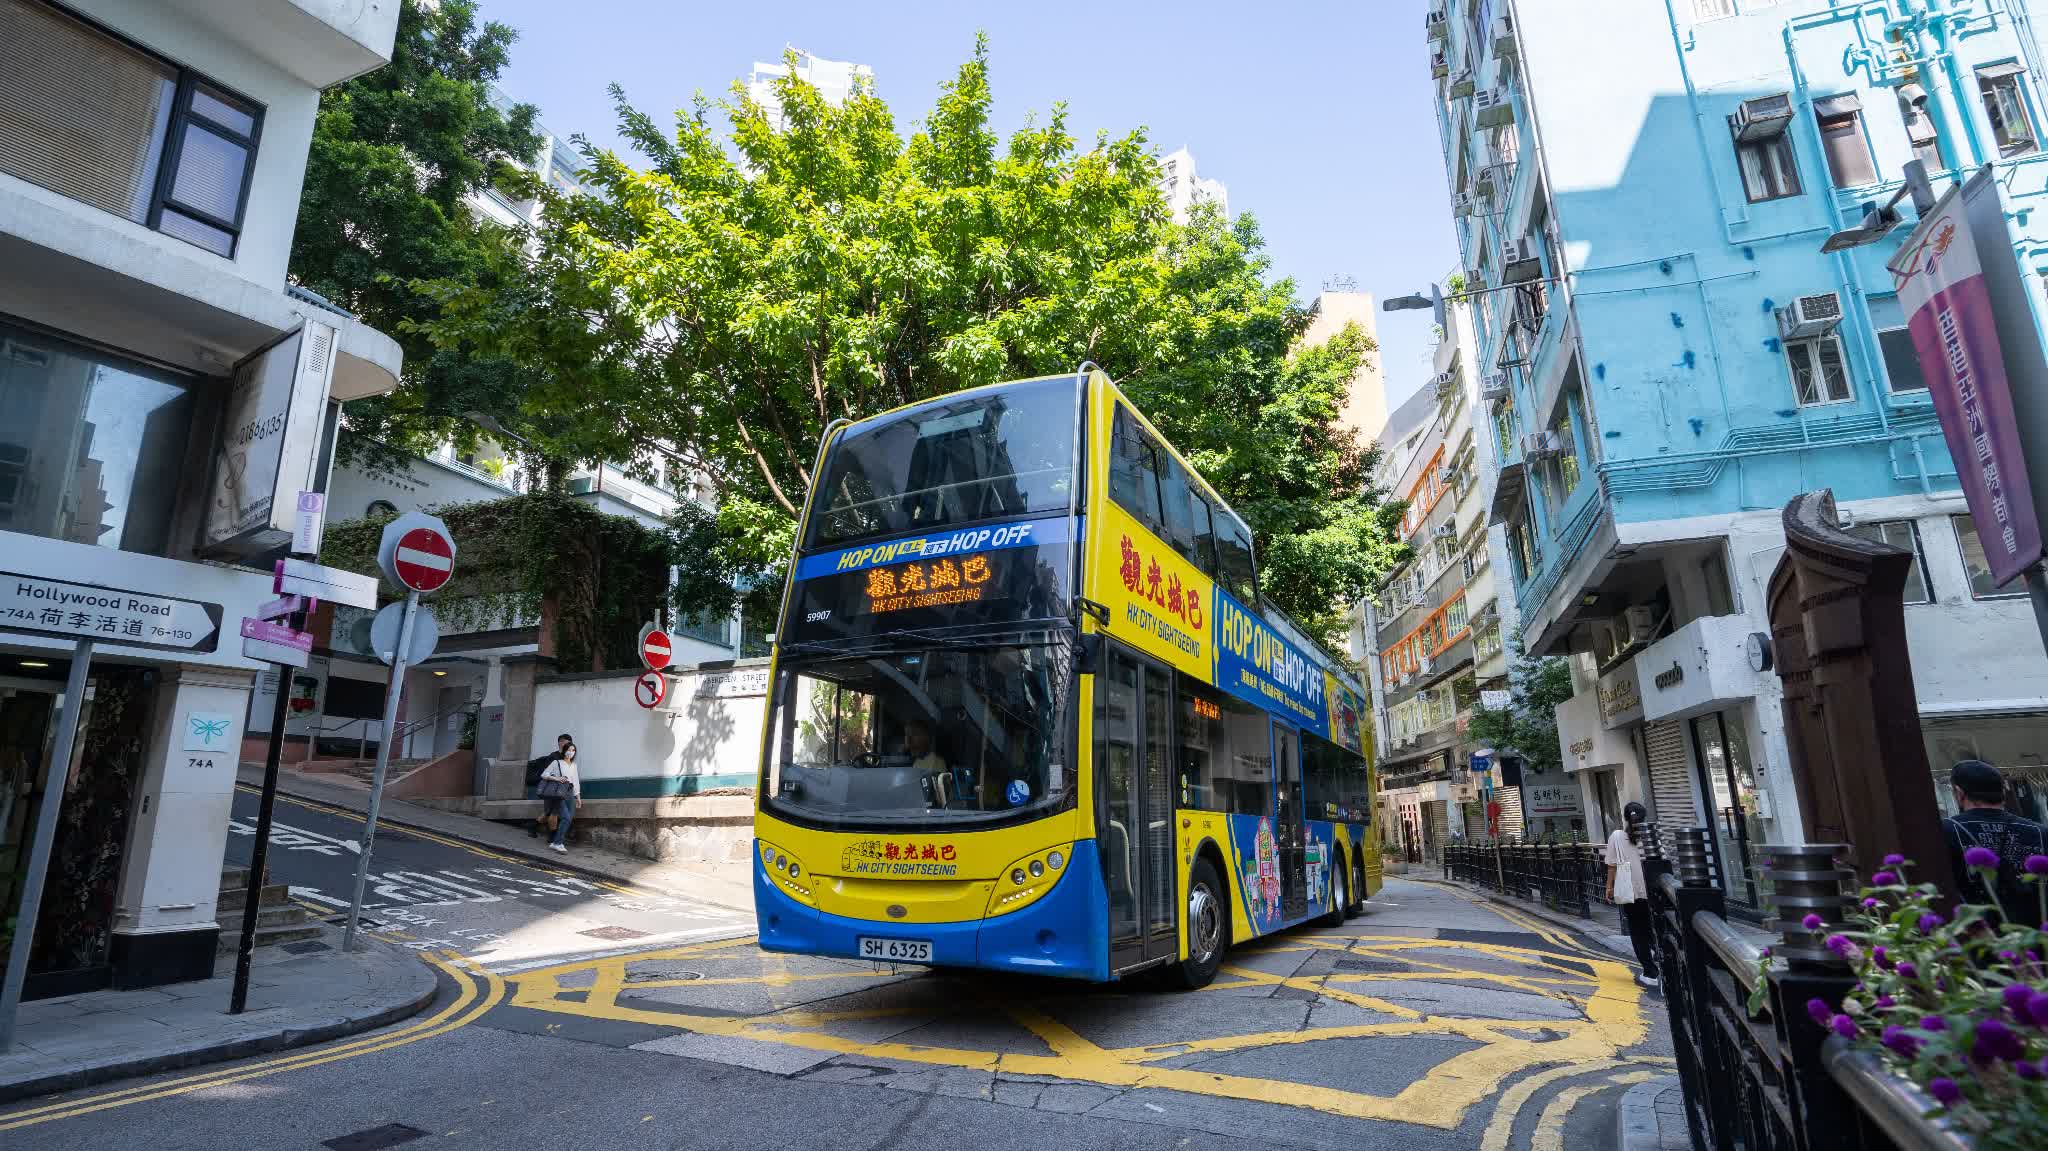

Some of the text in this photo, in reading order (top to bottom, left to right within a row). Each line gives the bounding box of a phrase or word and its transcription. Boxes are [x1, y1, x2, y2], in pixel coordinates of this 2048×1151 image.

[239, 412, 284, 446] 21866135
[837, 547, 874, 571] HOP
[872, 543, 900, 564] ON
[947, 529, 991, 552] HOP
[991, 524, 1033, 547] OFF
[866, 554, 991, 598] 觀光城巴
[1119, 533, 1203, 630] 觀光城巴
[17, 583, 171, 617] Hollywood Road
[888, 596, 912, 611] CITY
[913, 588, 981, 607] SIGHTSEEING
[39, 608, 145, 637] 荷李活道
[151, 626, 192, 641] 76-130
[806, 610, 832, 623] 59907
[1127, 601, 1201, 659] HK CITY SIGHTSEEING
[1222, 599, 1253, 660] HOP
[1253, 624, 1271, 674] ON
[1285, 647, 1305, 694] HOP
[1306, 663, 1322, 705] OFF
[743, 673, 768, 682] STREET
[188, 758, 213, 769] 74A
[883, 842, 957, 861] 觀光城巴
[856, 862, 957, 876] HK CITY SIGHTSEEING
[865, 940, 928, 959] SH 6325
